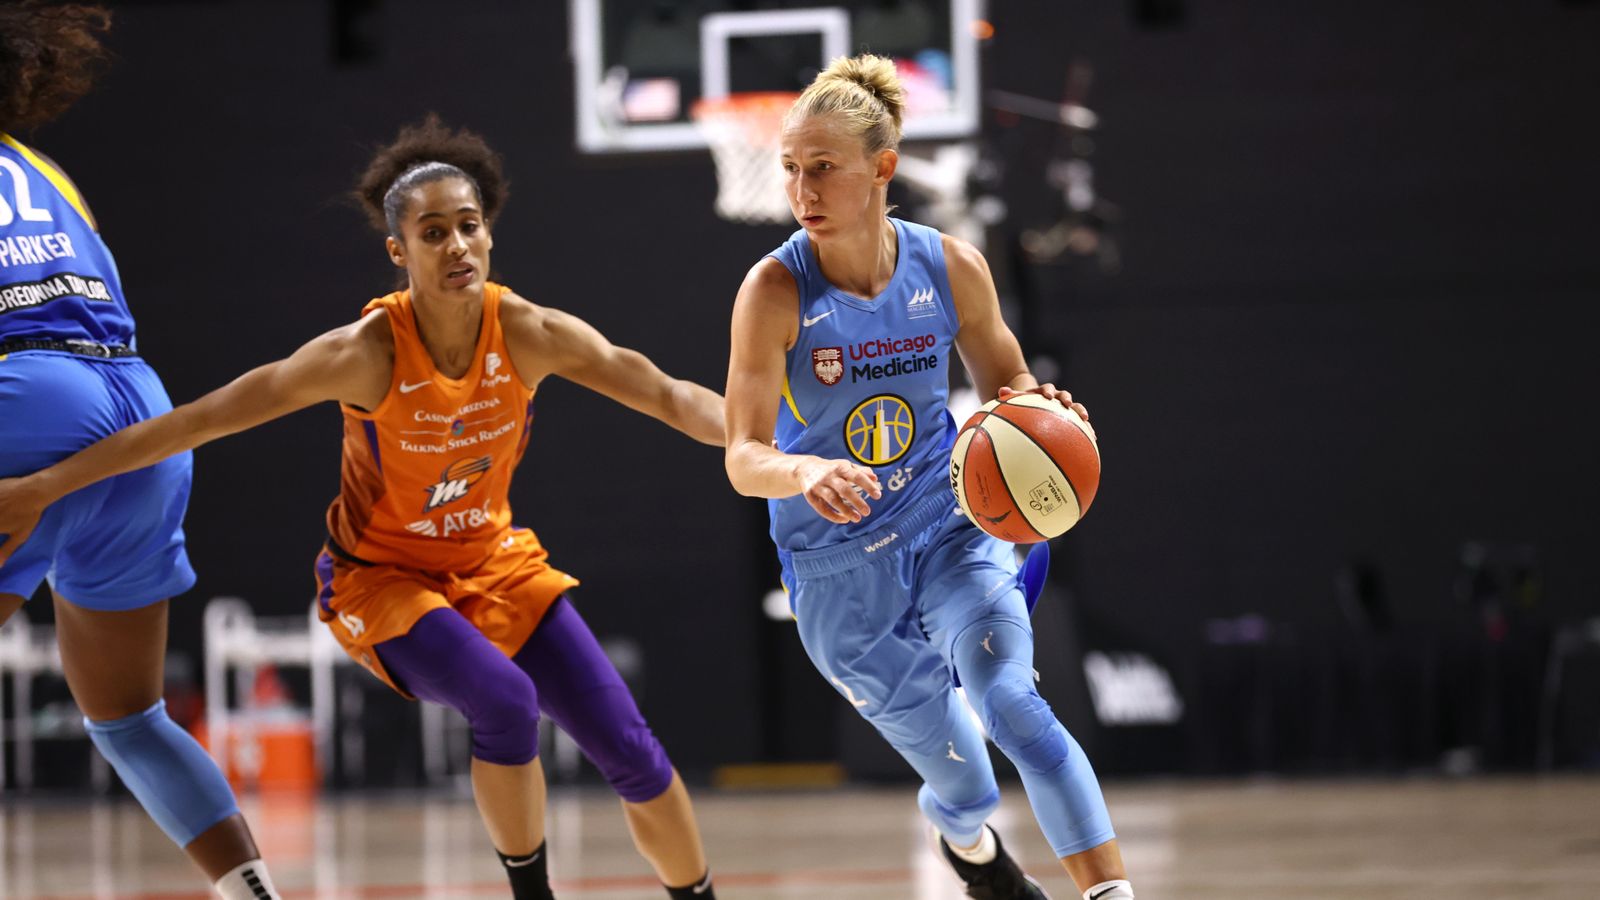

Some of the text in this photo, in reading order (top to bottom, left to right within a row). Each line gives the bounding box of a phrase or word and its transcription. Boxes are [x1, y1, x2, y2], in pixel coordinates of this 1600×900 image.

[0, 232, 76, 267] PARKER
[64, 275, 112, 300] TAYLOR
[849, 334, 936, 361] UChicago
[481, 373, 511, 388] PayPal
[852, 354, 938, 383] Medicine
[400, 420, 516, 454] TALKING STICK RESORT
[865, 533, 898, 552] WNBA
[338, 610, 365, 638] 4
